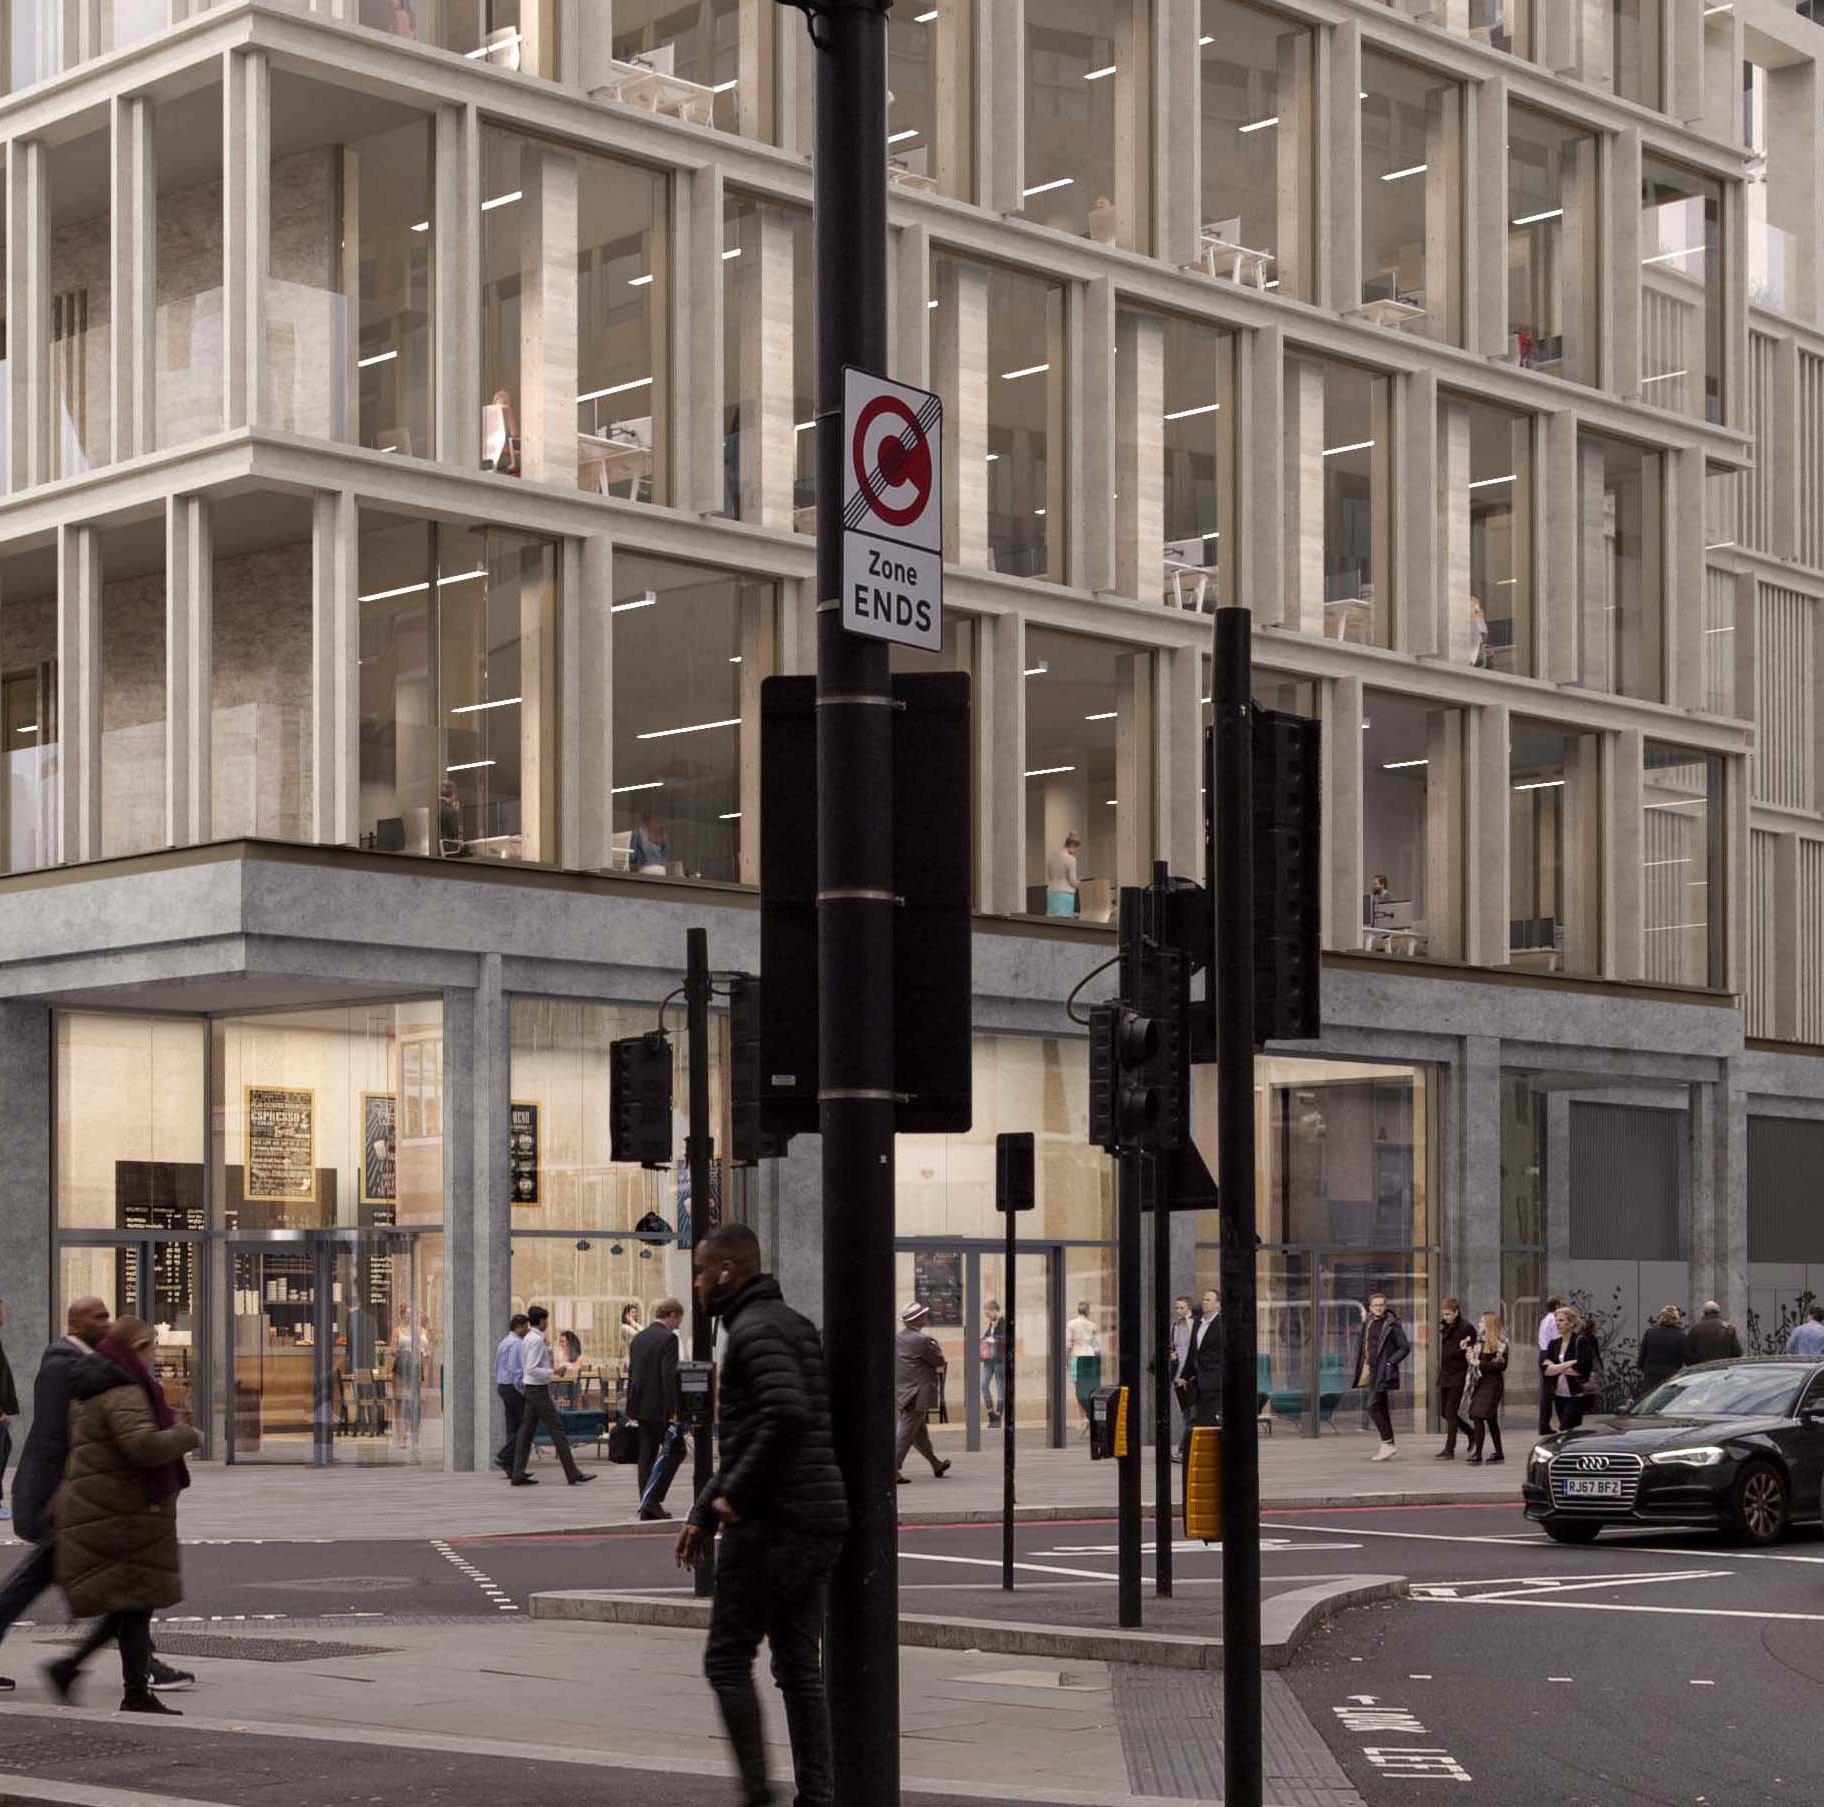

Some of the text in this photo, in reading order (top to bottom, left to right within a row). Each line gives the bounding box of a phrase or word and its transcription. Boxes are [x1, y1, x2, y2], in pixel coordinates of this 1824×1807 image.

[869, 549, 918, 586] Zone
[854, 583, 932, 633] ENDS
[1569, 1481, 1618, 1493] RJ67 BFZ
[1332, 1706, 1473, 1782] LOOK LEFT
